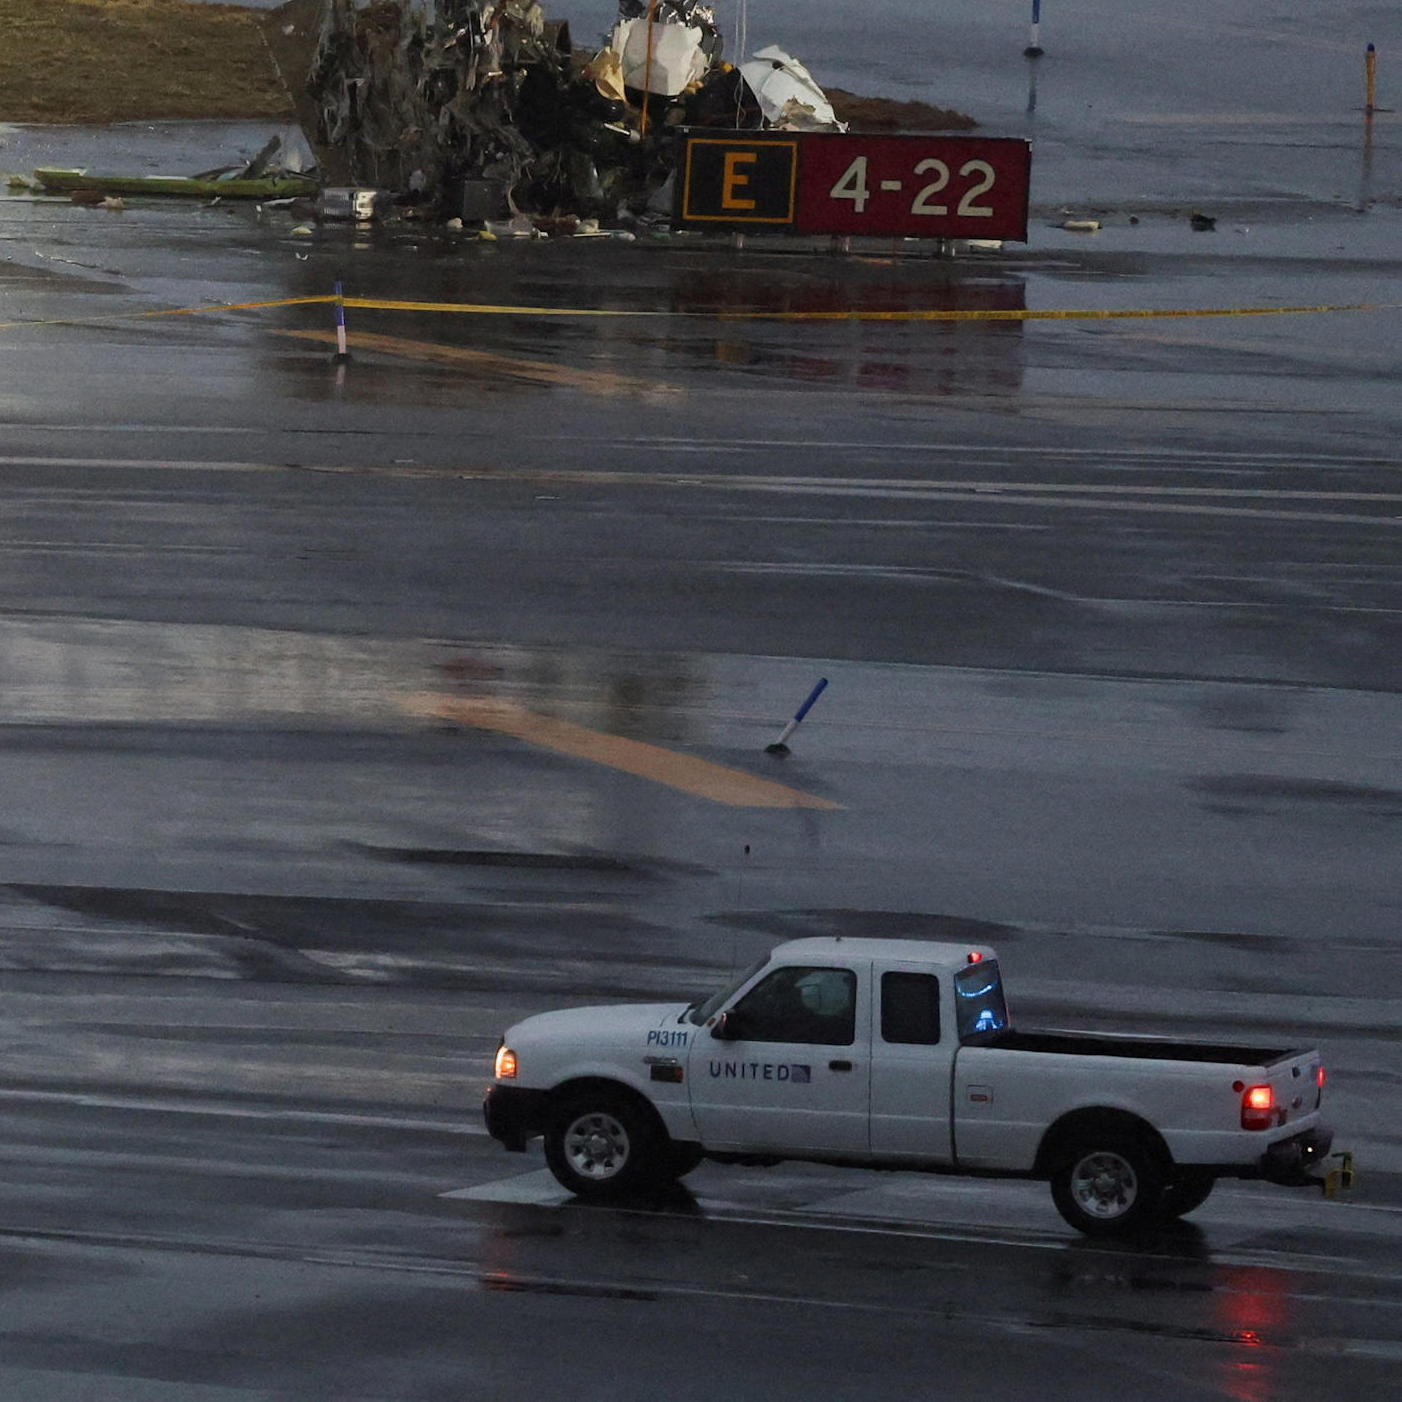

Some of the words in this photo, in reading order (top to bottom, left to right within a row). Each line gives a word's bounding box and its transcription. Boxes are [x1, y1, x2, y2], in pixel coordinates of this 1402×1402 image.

[721, 151, 758, 210] E
[829, 155, 997, 217] 4-22
[647, 1030, 688, 1047] PI3111
[709, 1061, 789, 1082] UNITED
